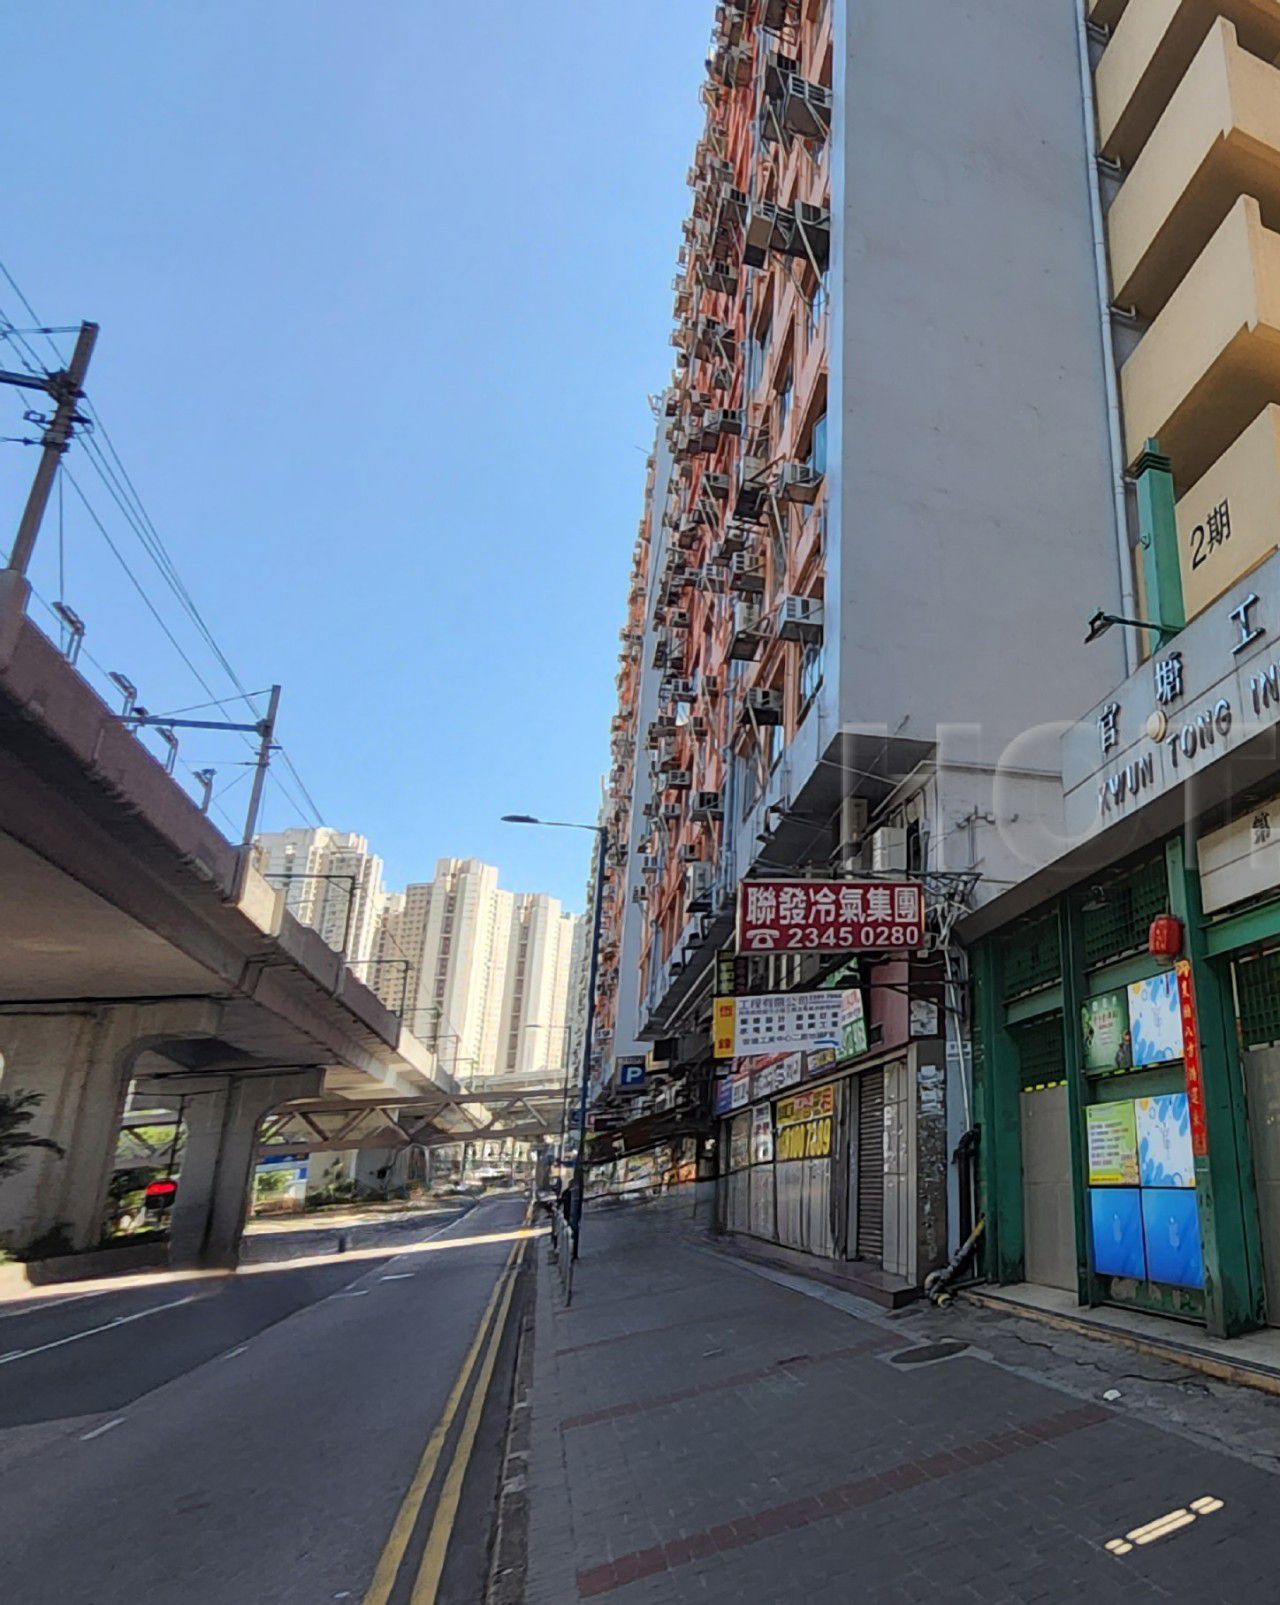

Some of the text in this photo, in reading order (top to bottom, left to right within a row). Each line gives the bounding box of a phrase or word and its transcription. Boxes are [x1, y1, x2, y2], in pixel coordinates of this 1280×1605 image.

[1189, 498, 1232, 571] 2期
[1097, 752, 1154, 816] KWUN
[1166, 698, 1232, 770] TONG
[746, 886, 921, 926] 聯發冷氣集團
[787, 925, 920, 949] 2345 0280
